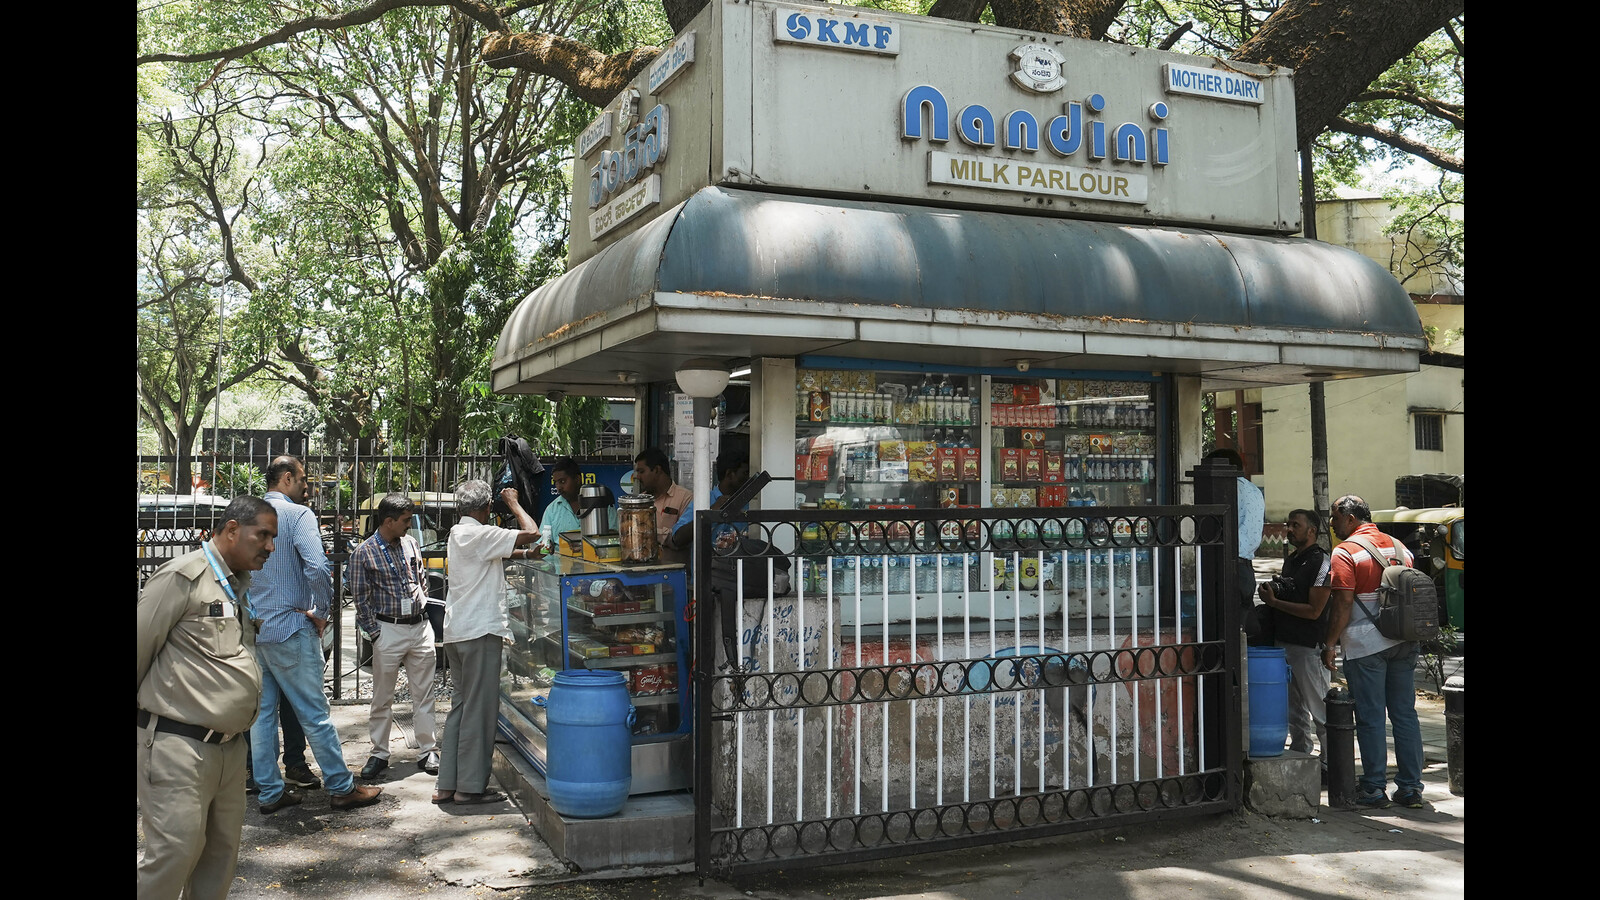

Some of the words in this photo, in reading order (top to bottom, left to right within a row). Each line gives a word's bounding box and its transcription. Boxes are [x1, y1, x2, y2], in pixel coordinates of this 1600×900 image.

[817, 18, 892, 49] KMF
[1172, 68, 1223, 93] MOTHER
[1225, 77, 1260, 98] DAIRY
[589, 104, 662, 207] ನಂದಿನಿ
[951, 158, 1010, 185] MILK
[1017, 166, 1129, 197] PARLOUR
